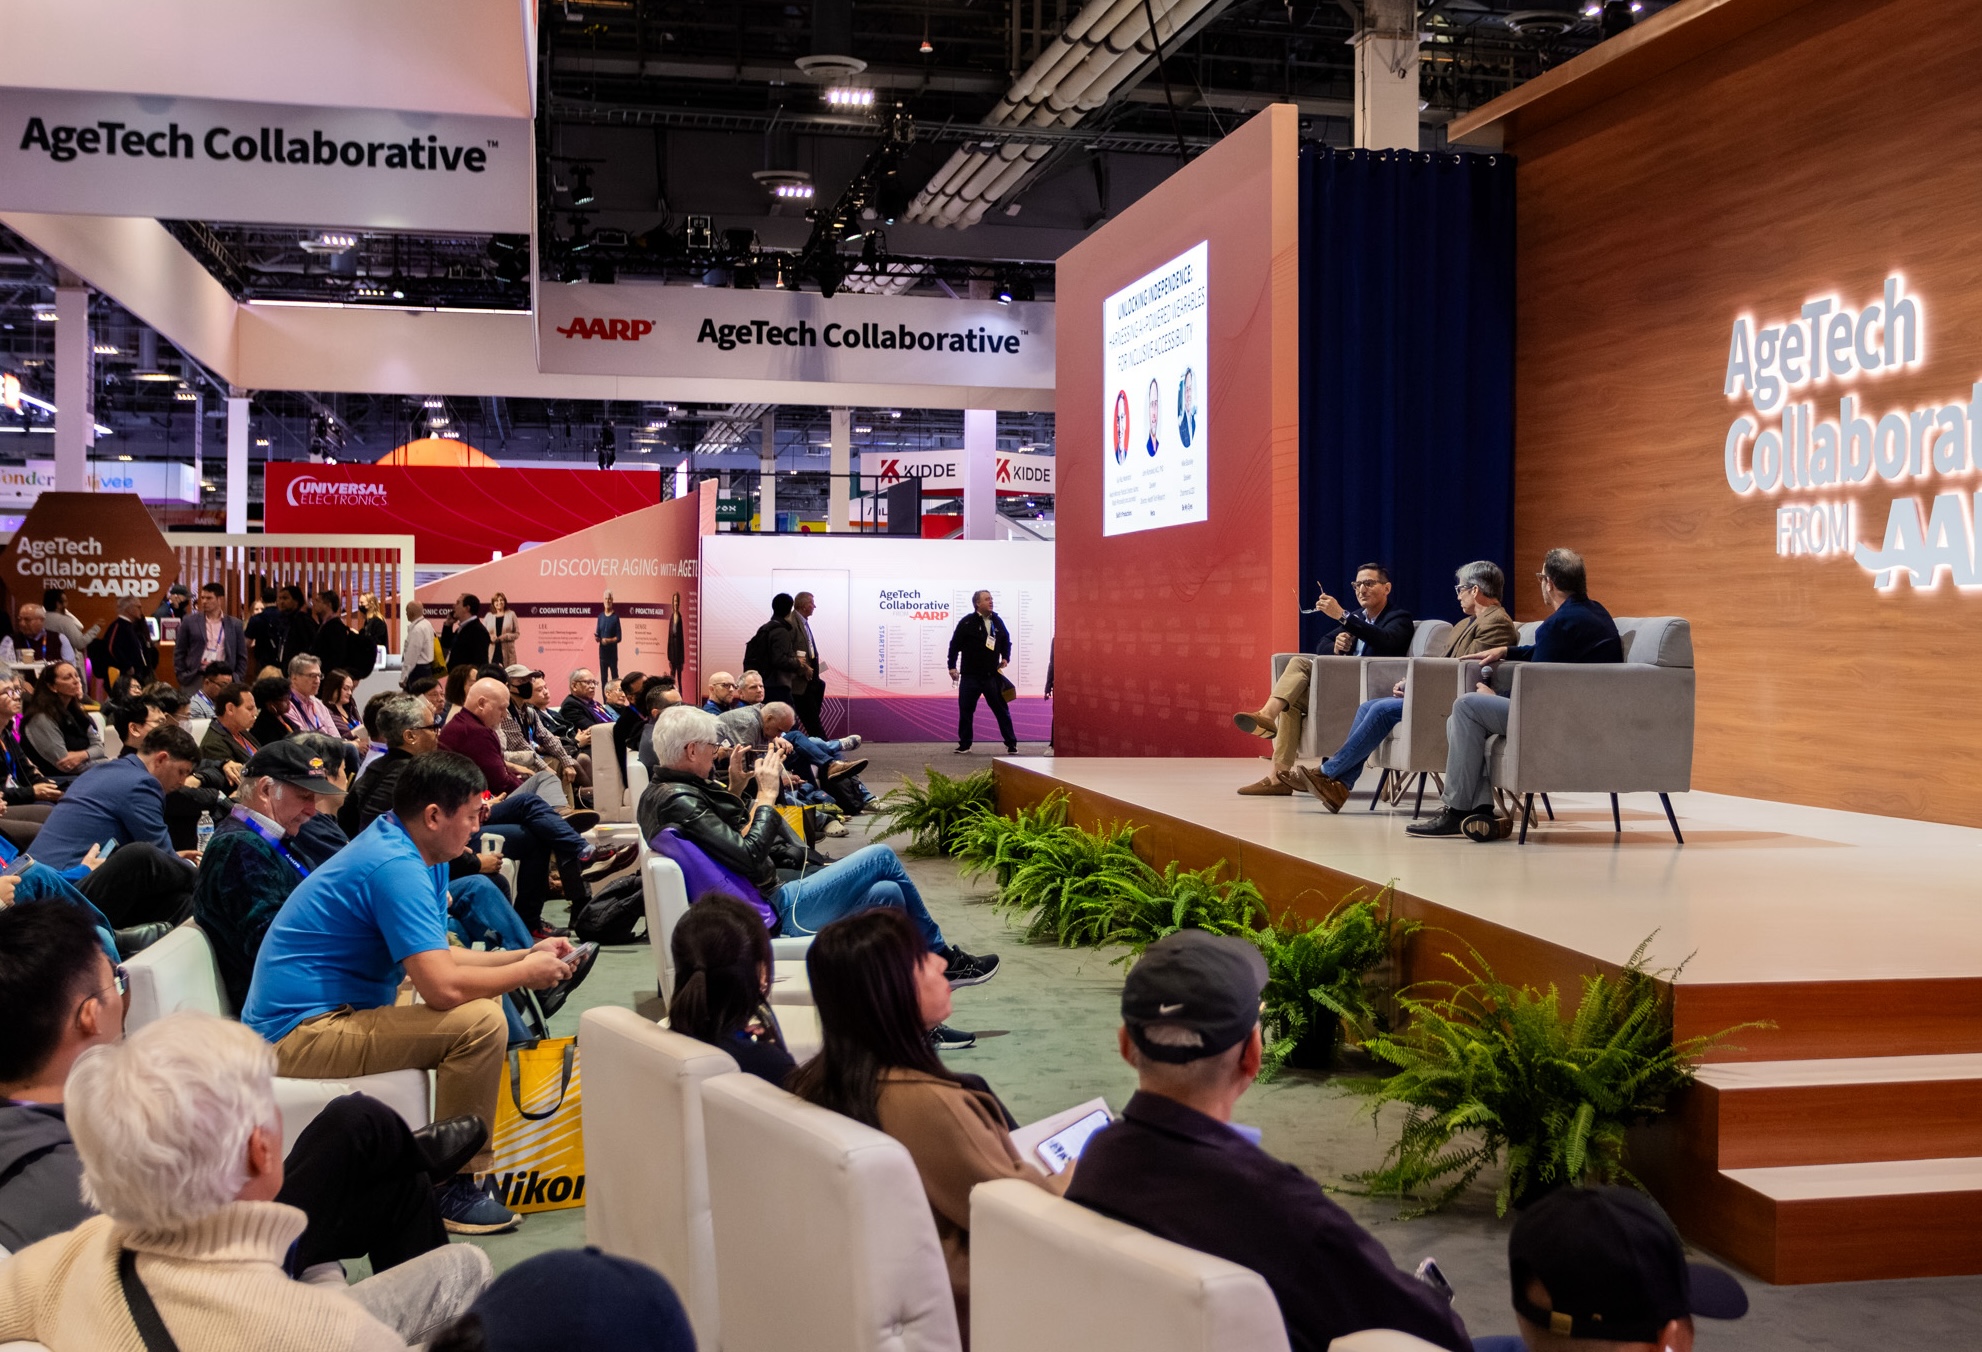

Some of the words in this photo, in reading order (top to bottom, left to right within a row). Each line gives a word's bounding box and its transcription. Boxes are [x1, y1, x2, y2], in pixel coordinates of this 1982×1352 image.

[19, 117, 194, 162] AgeTech
[1118, 289, 1147, 320] UNLOCKING
[1148, 264, 1193, 301] INDEPENDENCE:
[697, 318, 816, 350] AgeTech
[1724, 278, 1916, 411] AgeTech
[0, 470, 55, 486] onder
[904, 463, 956, 478] KIDDE
[1013, 465, 1050, 482] KIDDE
[299, 482, 387, 495] UNIVERSAL
[300, 494, 388, 506] ELECTRONICS
[16, 536, 102, 560] AgeTech
[1776, 503, 1850, 555] FROM
[1854, 491, 1982, 589] AA
[16, 558, 161, 577] Collaborative
[540, 558, 619, 577] DISCOVER
[621, 558, 659, 577] AGING
[660, 563, 677, 577] WITH
[43, 578, 77, 590] FROM
[78, 579, 160, 598] AARP
[879, 589, 921, 601] AgeTech
[539, 607, 568, 615] COGNITIVE
[569, 607, 591, 615] DECLINE
[635, 607, 655, 615] PROACTIVE
[879, 600, 950, 610] Collaborative
[909, 611, 949, 621] AARP
